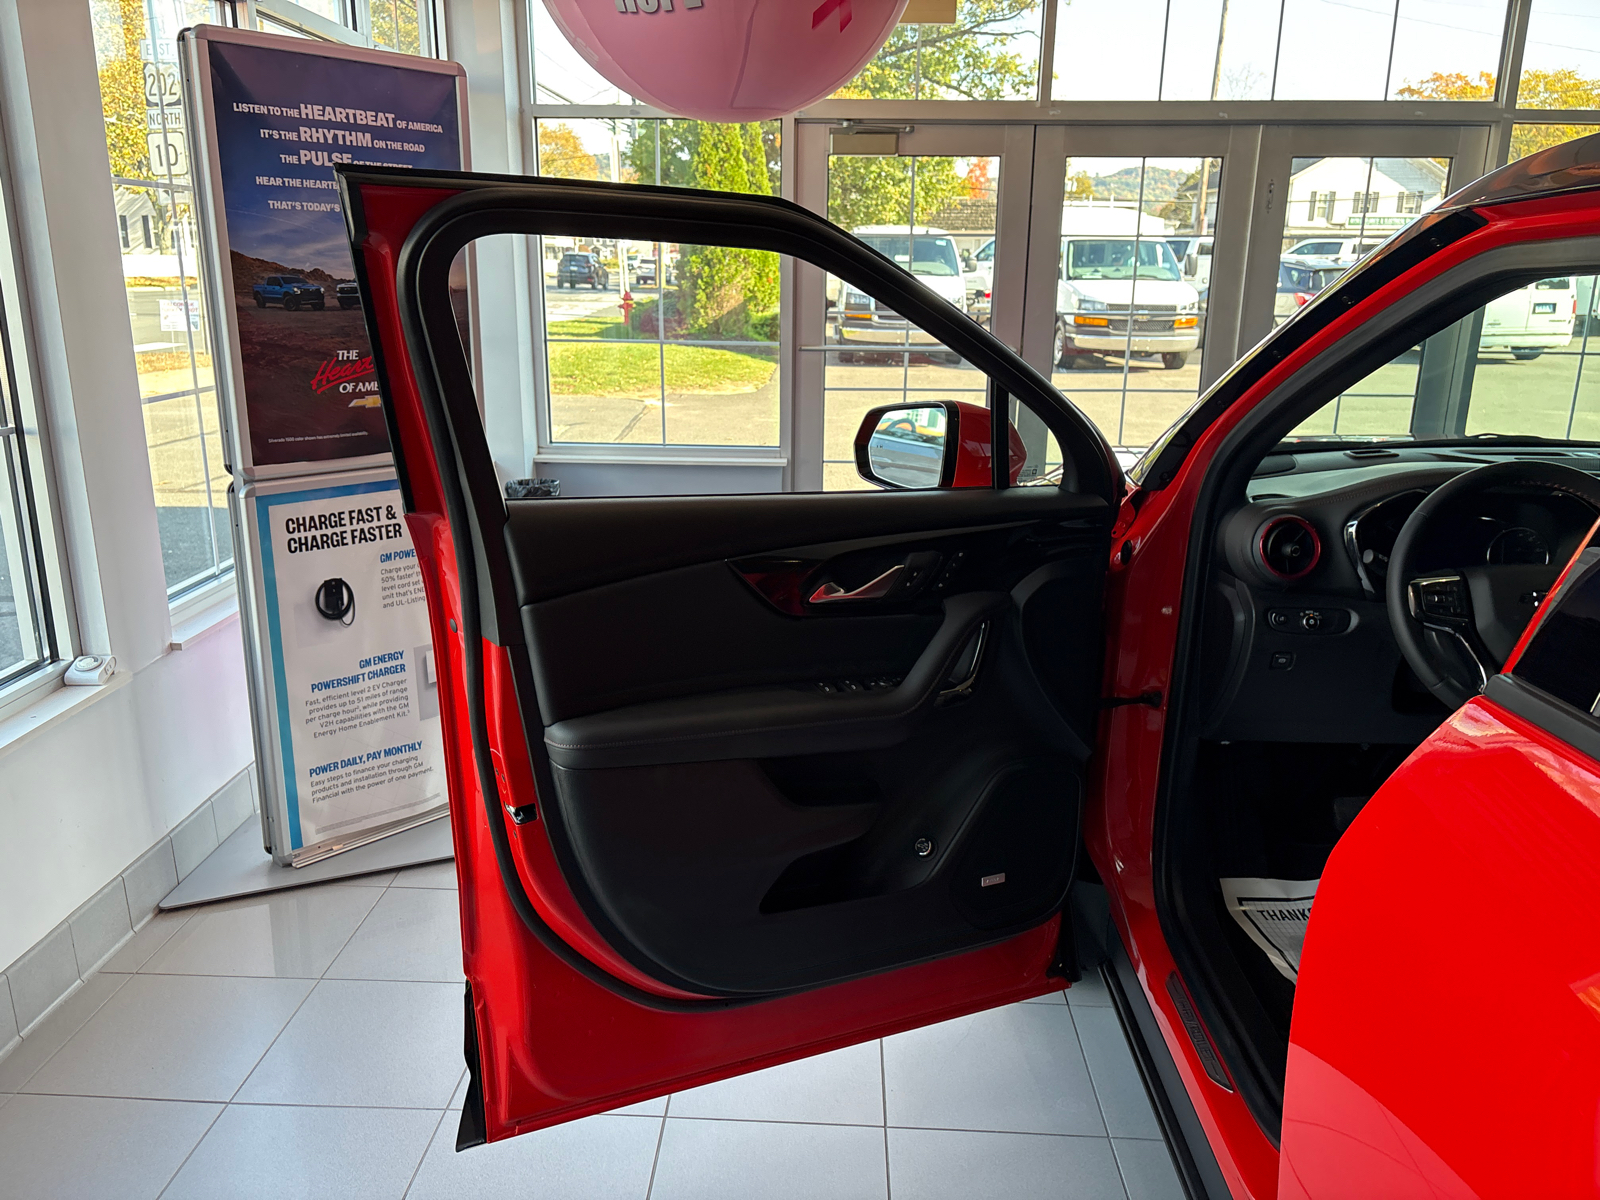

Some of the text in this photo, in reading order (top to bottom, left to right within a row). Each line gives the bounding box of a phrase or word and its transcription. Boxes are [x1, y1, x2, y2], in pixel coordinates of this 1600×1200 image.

[146, 43, 170, 56] EST
[233, 102, 443, 133] LISTEN TO THE HEARTBEAT OF AMERICA
[260, 126, 425, 153] IT'S THE RHYTHM ON THE ROAD
[279, 154, 300, 164] THE
[299, 149, 352, 167] PULSE
[255, 176, 283, 186] HEAR
[283, 177, 303, 188] THE
[268, 200, 340, 212] THAT'S TODAY'S
[337, 350, 359, 360] THE
[310, 355, 374, 390] Heart
[339, 382, 355, 393] OF
[285, 504, 397, 535] CHARGE FAST &
[287, 522, 403, 554] CHARGE FASTER
[380, 552, 392, 563] GM
[380, 566, 402, 576] Charge
[403, 563, 416, 572] your
[381, 575, 396, 584] 50%
[381, 583, 396, 592] level
[397, 581, 411, 589] cord
[382, 592, 395, 601] unit
[395, 588, 413, 598] that's
[382, 601, 395, 609] and
[359, 649, 405, 669] GM ENERGY
[311, 663, 406, 693] POWERSHIFT CHARGER
[305, 678, 407, 707] Fast, efficient level 2 EV Charger
[308, 702, 338, 715] provides
[338, 701, 348, 710] up
[356, 696, 364, 704] 51
[364, 692, 381, 701] miles
[381, 689, 388, 697] of
[389, 686, 408, 696] range
[305, 715, 317, 725] per
[317, 709, 341, 721] charge
[362, 700, 379, 710] while
[379, 694, 409, 706] providing
[320, 702, 409, 728] V2H capabilities with the GM
[313, 728, 337, 739] Energy
[338, 723, 358, 732] Home
[359, 713, 395, 728] Enablement
[309, 740, 422, 778] POWER DAILY, PAY MONTHLY
[310, 755, 419, 788] Easy steps to finance your charging
[311, 761, 424, 796] products and installation through GM
[312, 765, 434, 804] Financial with the power of one payment.
